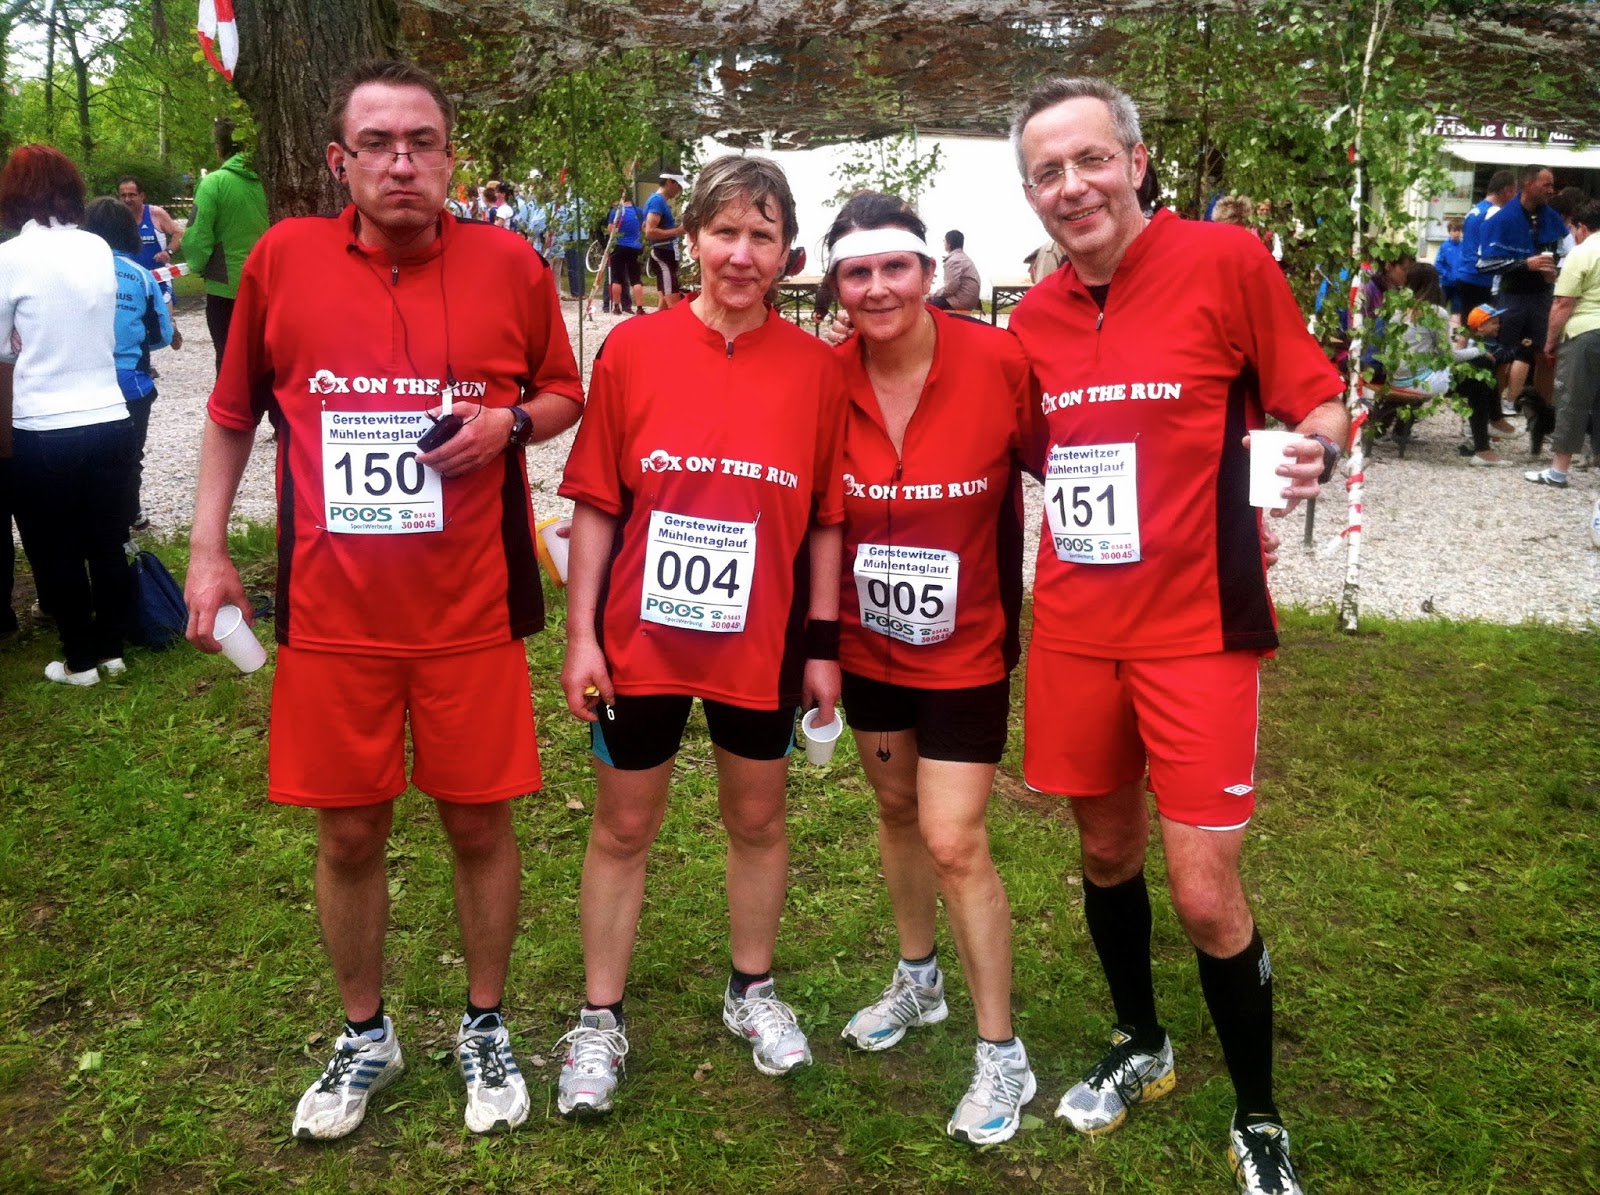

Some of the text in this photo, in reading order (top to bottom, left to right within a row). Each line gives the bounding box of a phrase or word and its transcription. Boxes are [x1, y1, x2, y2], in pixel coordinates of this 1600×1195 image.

[308, 369, 487, 397] FOX ON THE RUN
[1041, 383, 1182, 415] OX ON THE RUN
[333, 414, 422, 425] Gerstewitzer
[1048, 449, 1120, 461] Gerstewitzer
[334, 451, 426, 496] 150
[640, 449, 799, 489] FOX ON THE RUN
[1047, 461, 1125, 475] Mühlentaglauf
[842, 473, 988, 500] OX ON THE RUN
[330, 507, 393, 522] POOS
[1052, 484, 1115, 528] 151
[664, 515, 745, 535] Gerstewitzer
[658, 528, 748, 548] Mühlentaglauf
[869, 546, 946, 561] Gerstewitzer
[657, 550, 740, 599] 004
[863, 559, 950, 575] Mühlentaglauf
[646, 597, 705, 620] POOS
[867, 578, 944, 619] 005
